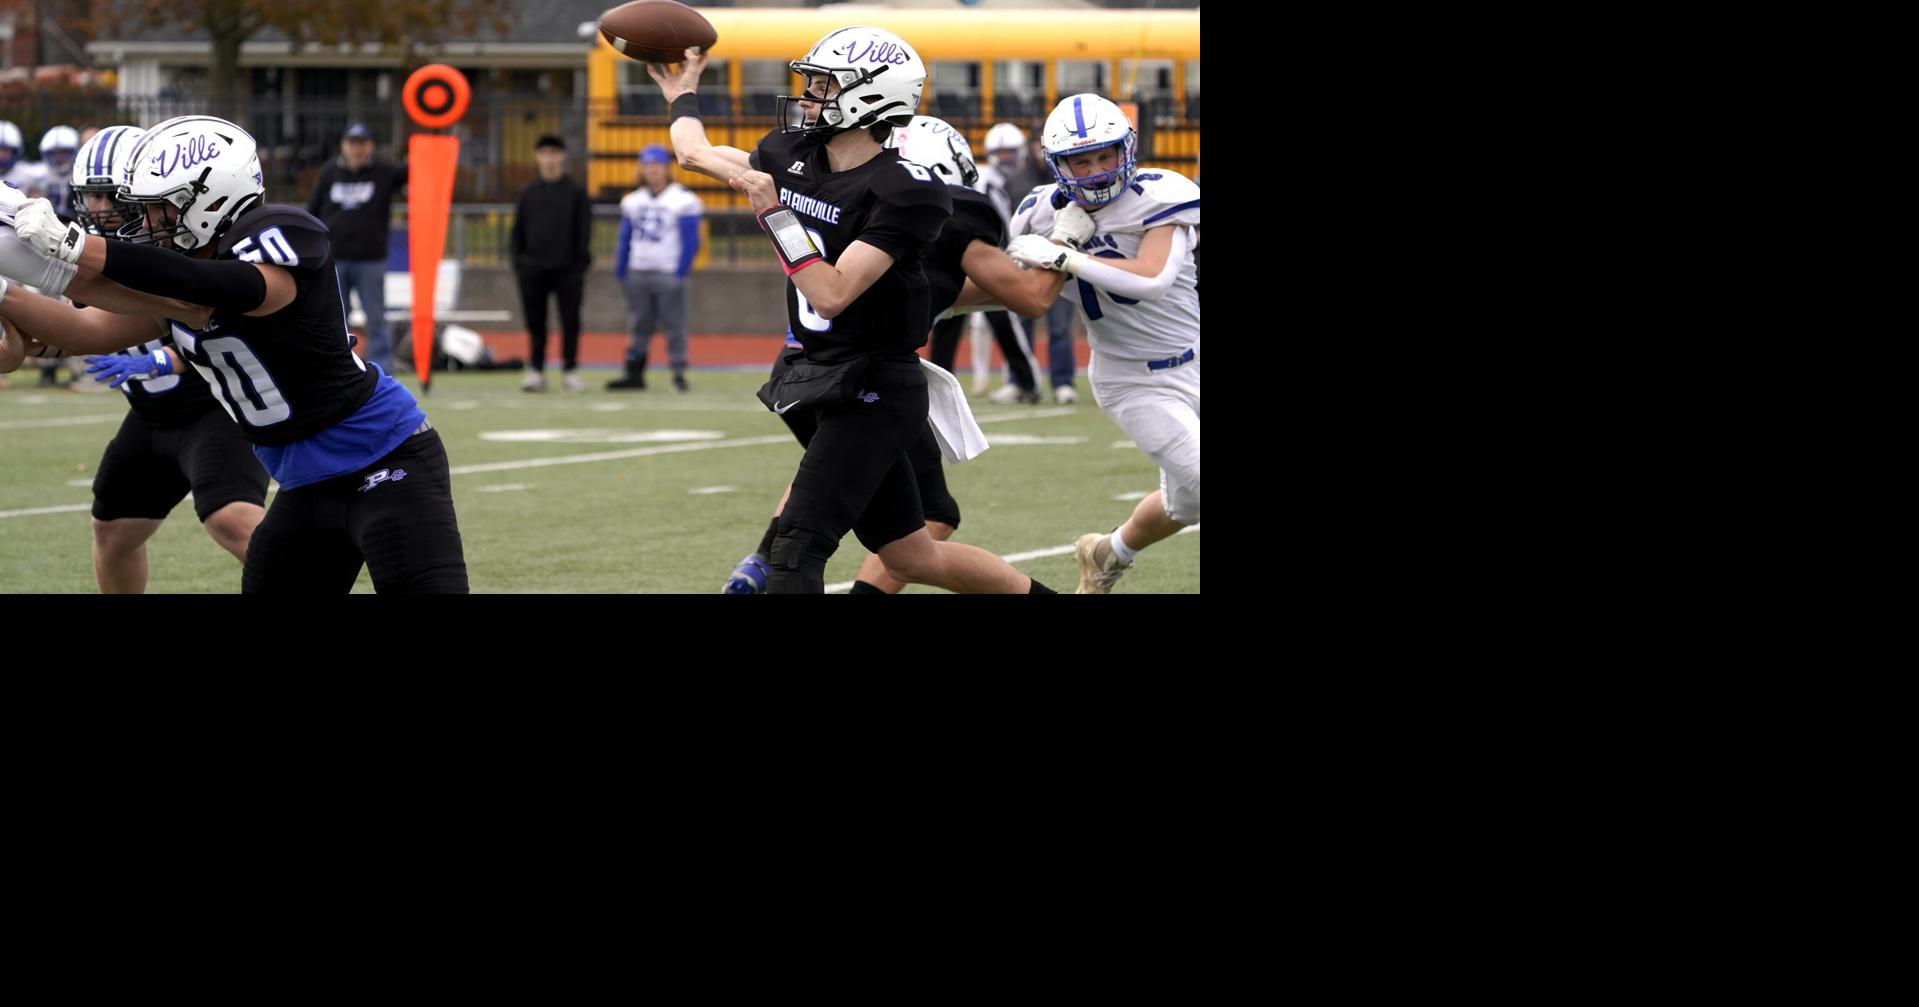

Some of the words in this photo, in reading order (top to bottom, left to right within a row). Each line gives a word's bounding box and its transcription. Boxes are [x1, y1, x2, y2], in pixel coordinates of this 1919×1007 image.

[896, 160, 933, 183] 6
[780, 187, 841, 225] PLAINVILLE
[231, 225, 299, 267] 50
[171, 319, 292, 428] 50
